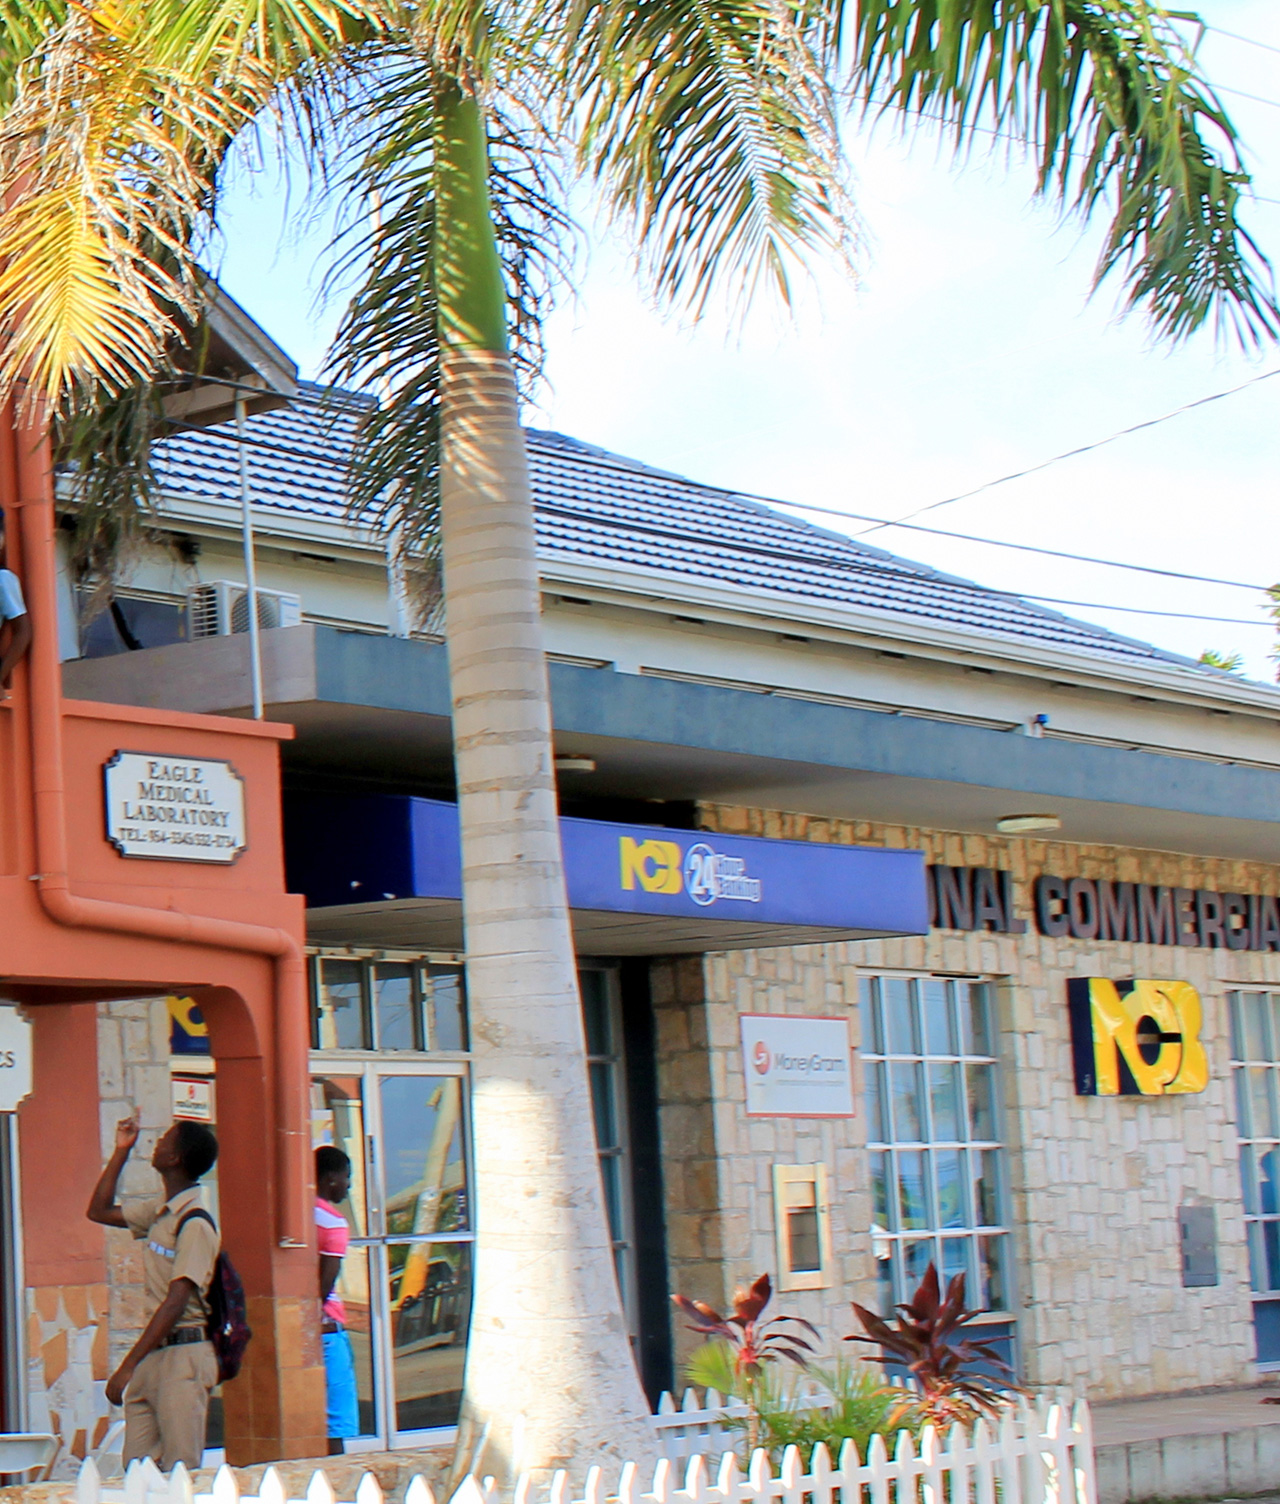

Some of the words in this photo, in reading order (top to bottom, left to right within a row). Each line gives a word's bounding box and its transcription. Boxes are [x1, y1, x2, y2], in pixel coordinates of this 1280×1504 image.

[147, 761, 204, 784] EAGLE
[138, 781, 215, 806] MEDICAL
[122, 800, 231, 828] LABORATORY
[619, 836, 683, 895] NCB
[1080, 976, 1210, 1096] NCB
